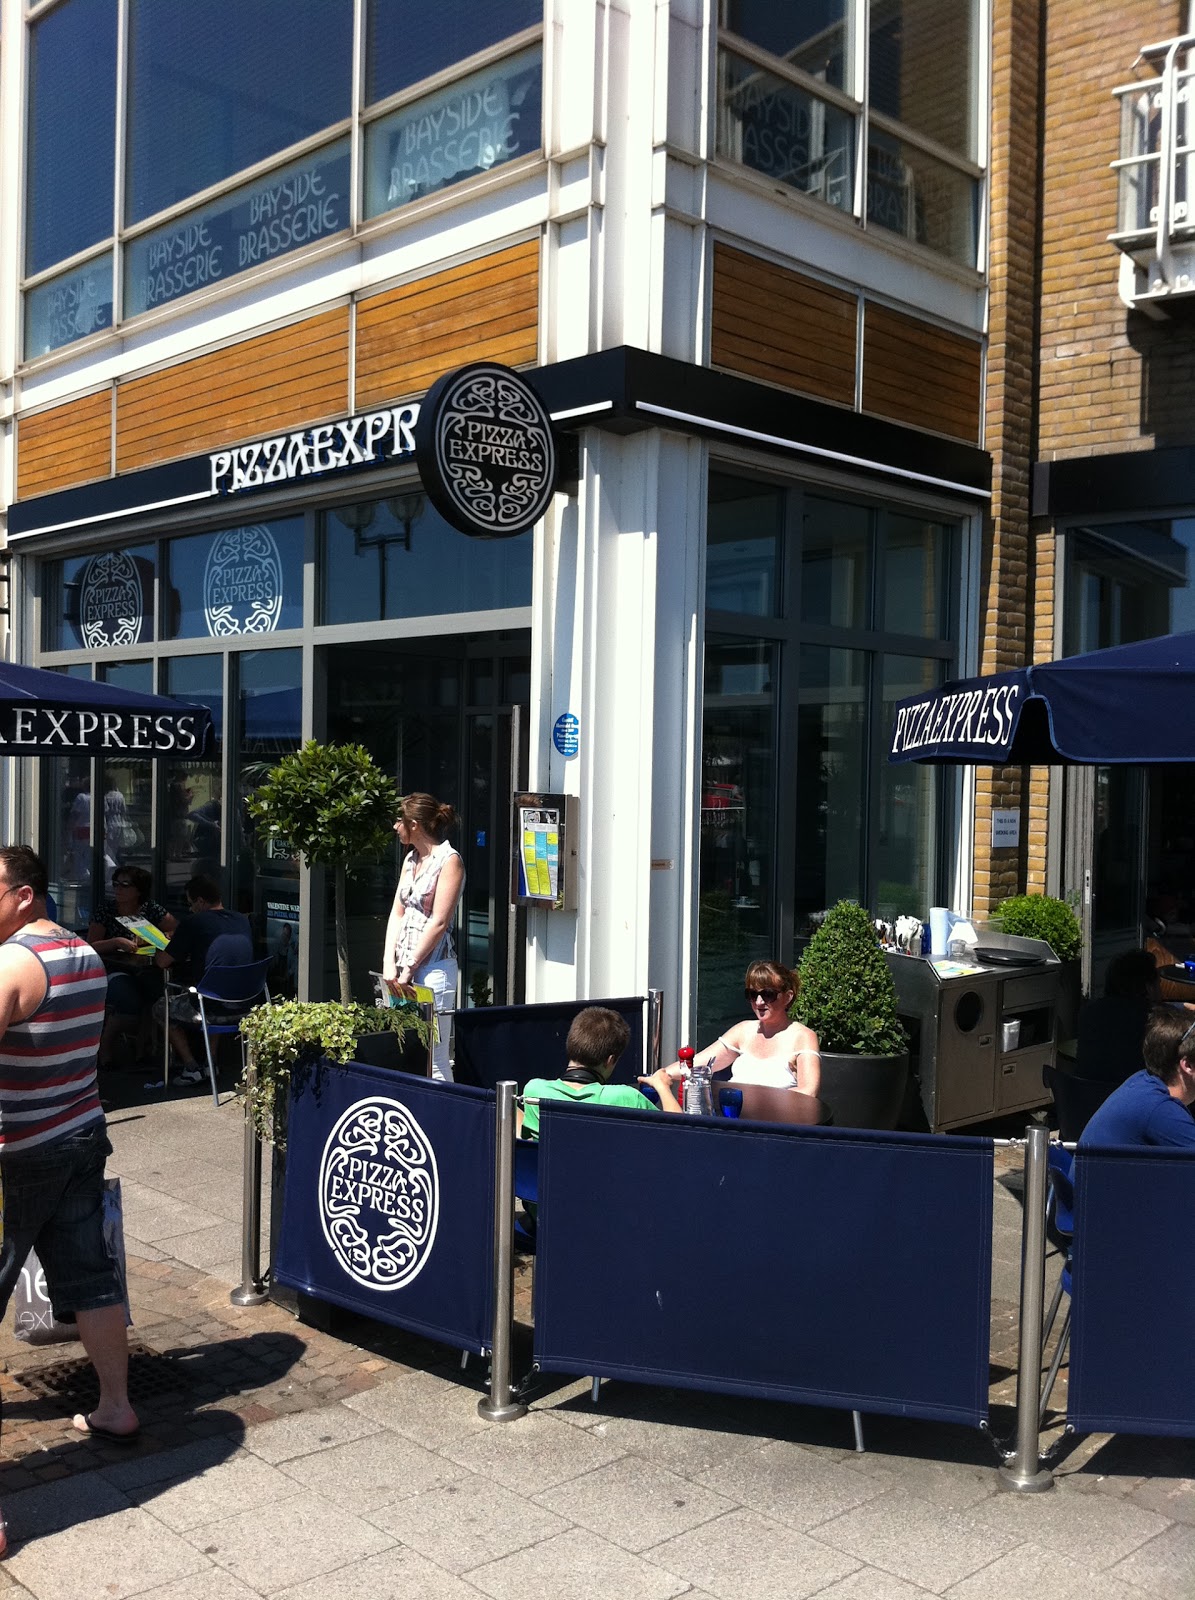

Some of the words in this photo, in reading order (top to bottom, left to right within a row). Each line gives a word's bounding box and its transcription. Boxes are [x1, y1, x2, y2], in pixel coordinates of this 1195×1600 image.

[405, 87, 503, 156] BAYSIDE
[249, 169, 326, 226] BAYSIDE
[149, 222, 212, 271] BAYSIDE
[239, 193, 339, 267] BRASSERIE
[141, 245, 222, 305] BRASSERIE
[467, 421, 531, 449] PIZZA
[449, 439, 544, 473] EXPRESS
[95, 586, 127, 602] PIZZA
[213, 581, 273, 605] EXPRESS
[223, 565, 263, 587] PIZZA
[87, 600, 136, 621] EXPRESS
[0, 707, 196, 751] EXPRESS
[892, 685, 1019, 753] PIZZAEXPRESS
[348, 1157, 408, 1195] PIZZA
[330, 1176, 425, 1223] EXPRESS
[16, 1304, 54, 1331] ext
